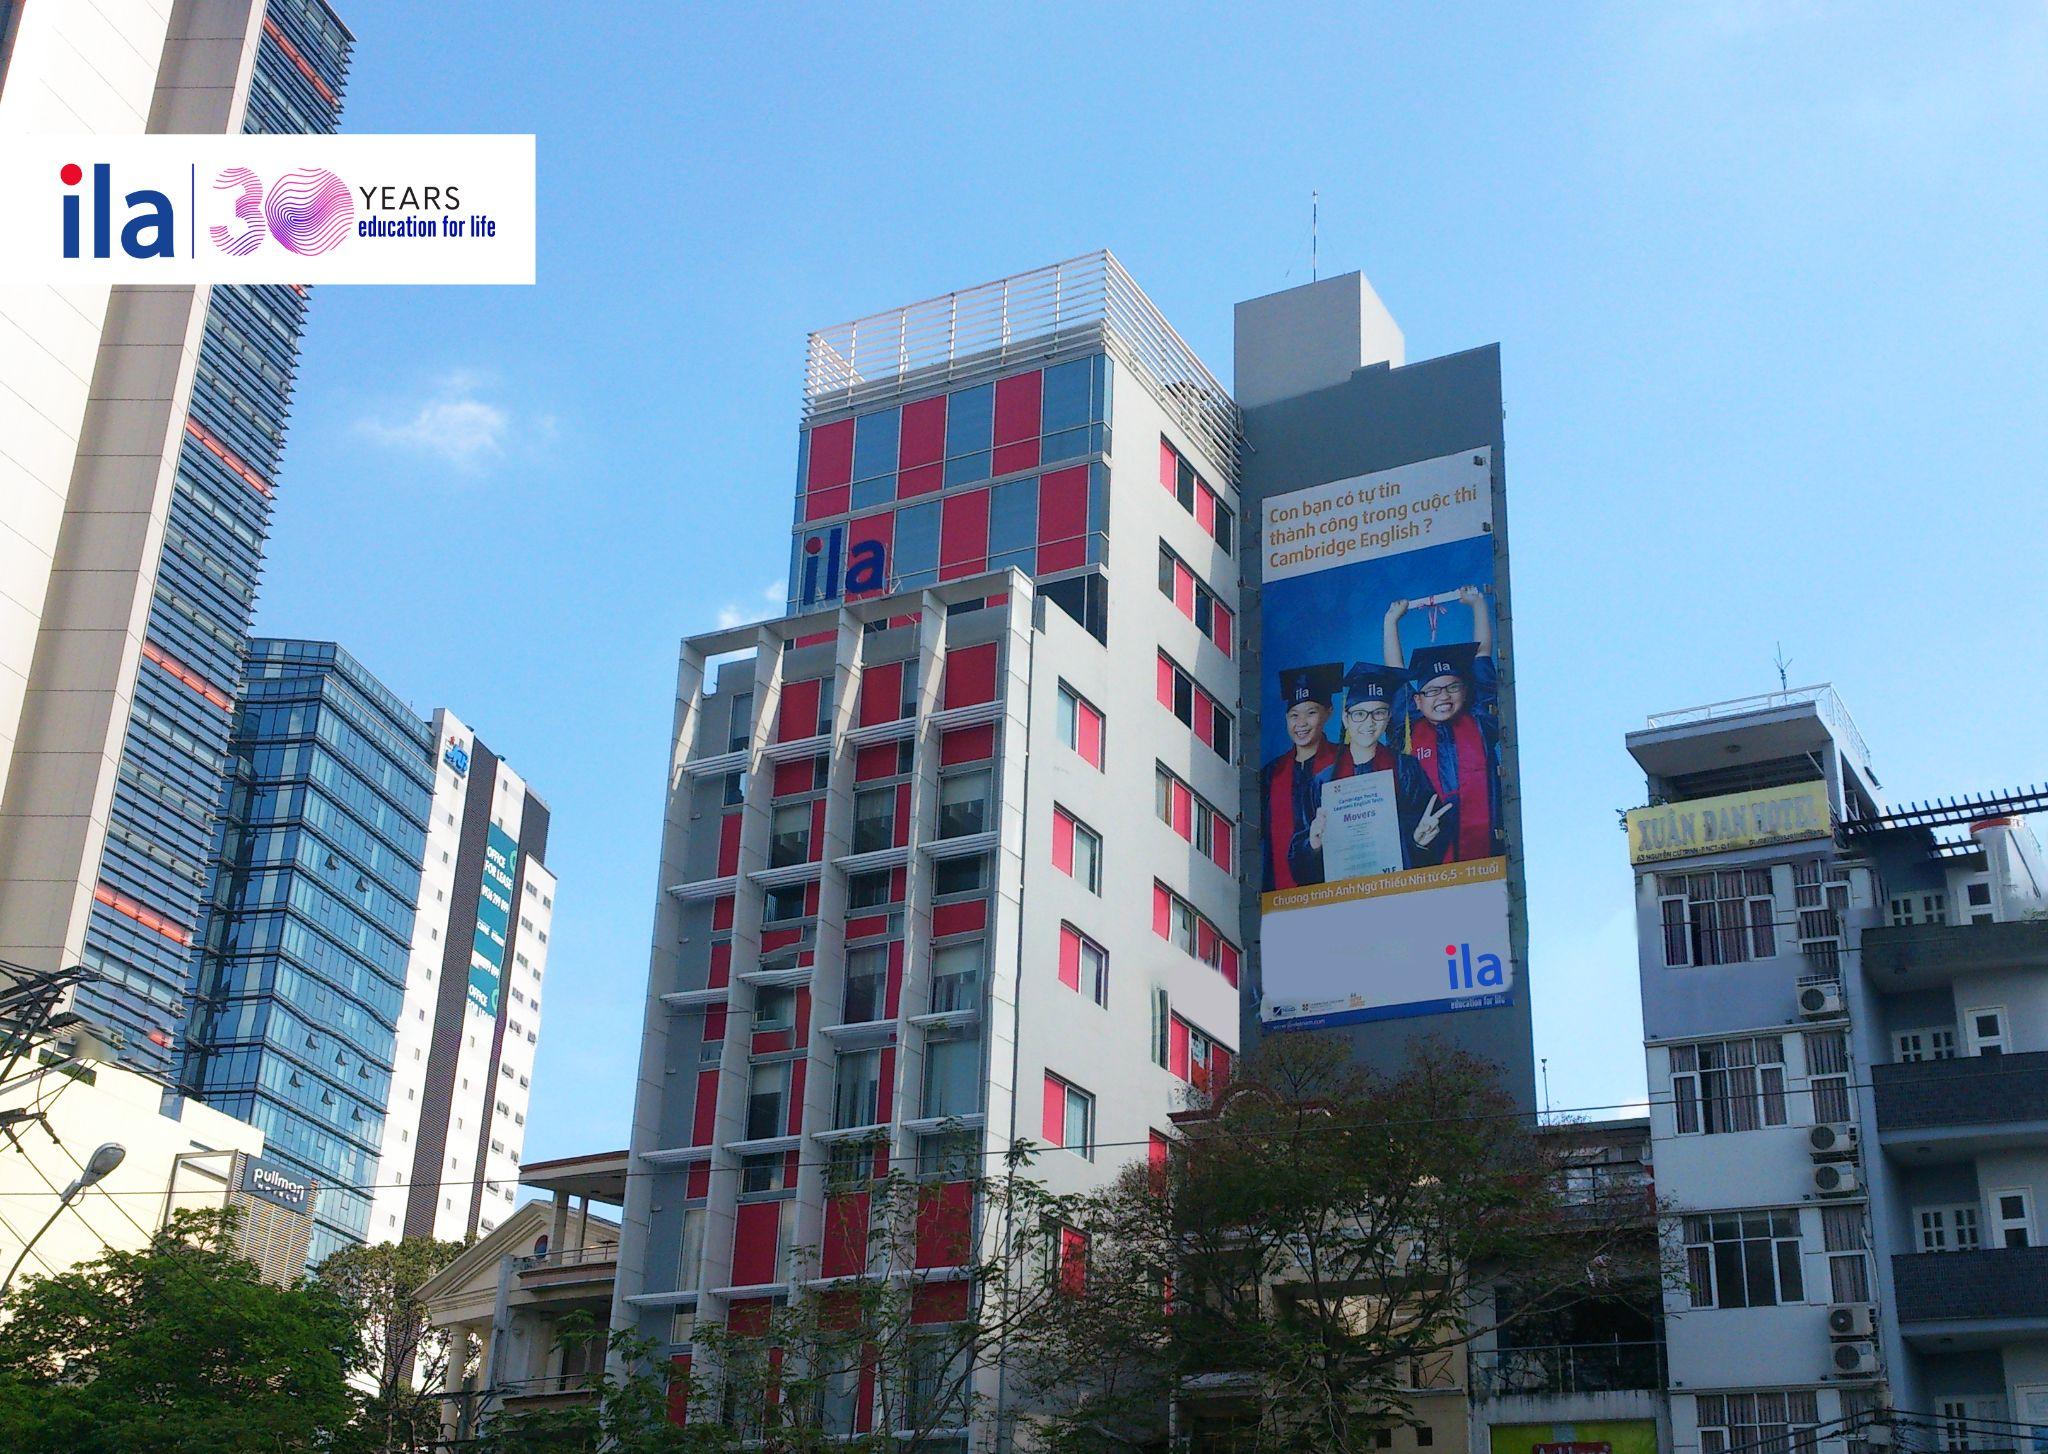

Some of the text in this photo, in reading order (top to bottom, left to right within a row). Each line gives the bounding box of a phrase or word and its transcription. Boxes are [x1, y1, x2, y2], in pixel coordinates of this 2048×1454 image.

[1269, 484, 1478, 546] thành công trong cuộc thi
[1270, 506, 1299, 524] Con
[1303, 499, 1332, 518] bạn
[1336, 490, 1354, 506] có
[1379, 481, 1401, 499] tin
[1270, 517, 1433, 568] Cambridge English ?
[803, 527, 886, 606] ila
[1434, 661, 1451, 674] ila
[1295, 687, 1310, 700] ila
[1368, 683, 1384, 697] ila
[1416, 747, 1432, 761] ila
[1343, 809, 1376, 823] Movers
[487, 845, 506, 869] OFFICE
[484, 859, 513, 891] FOR LEASE
[1336, 884, 1355, 896] Anh
[1408, 872, 1426, 885] Nhi
[1440, 868, 1458, 881] 6,5
[1465, 865, 1477, 876] 11
[1445, 943, 1504, 990] ila
[468, 984, 488, 1008] OFFICE
[1450, 996, 1482, 1010] education
[1483, 994, 1493, 1006] for
[253, 1168, 305, 1201] pullman
